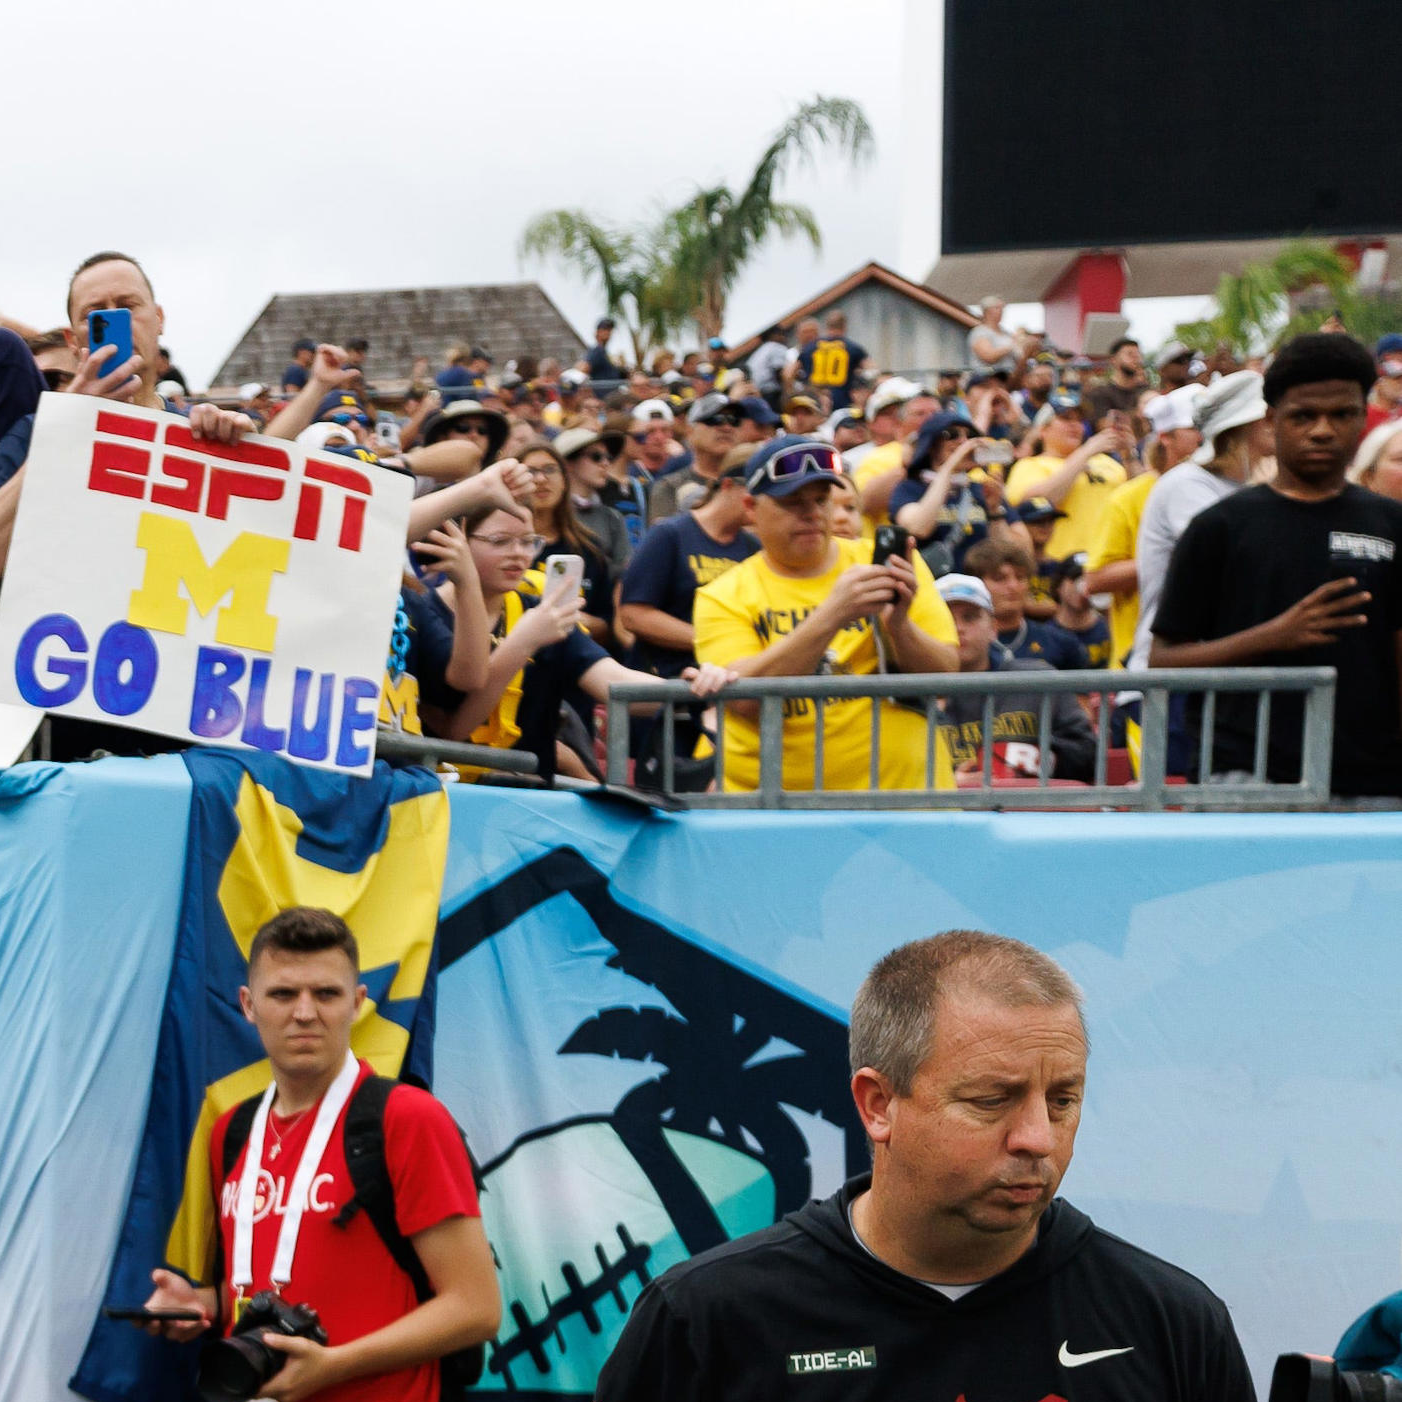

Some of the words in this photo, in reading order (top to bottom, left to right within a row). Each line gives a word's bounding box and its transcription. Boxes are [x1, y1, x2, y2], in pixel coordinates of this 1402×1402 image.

[87, 410, 373, 553] ESPN
[126, 511, 292, 653] M
[14, 613, 159, 717] GO
[188, 645, 380, 768] BLUE
